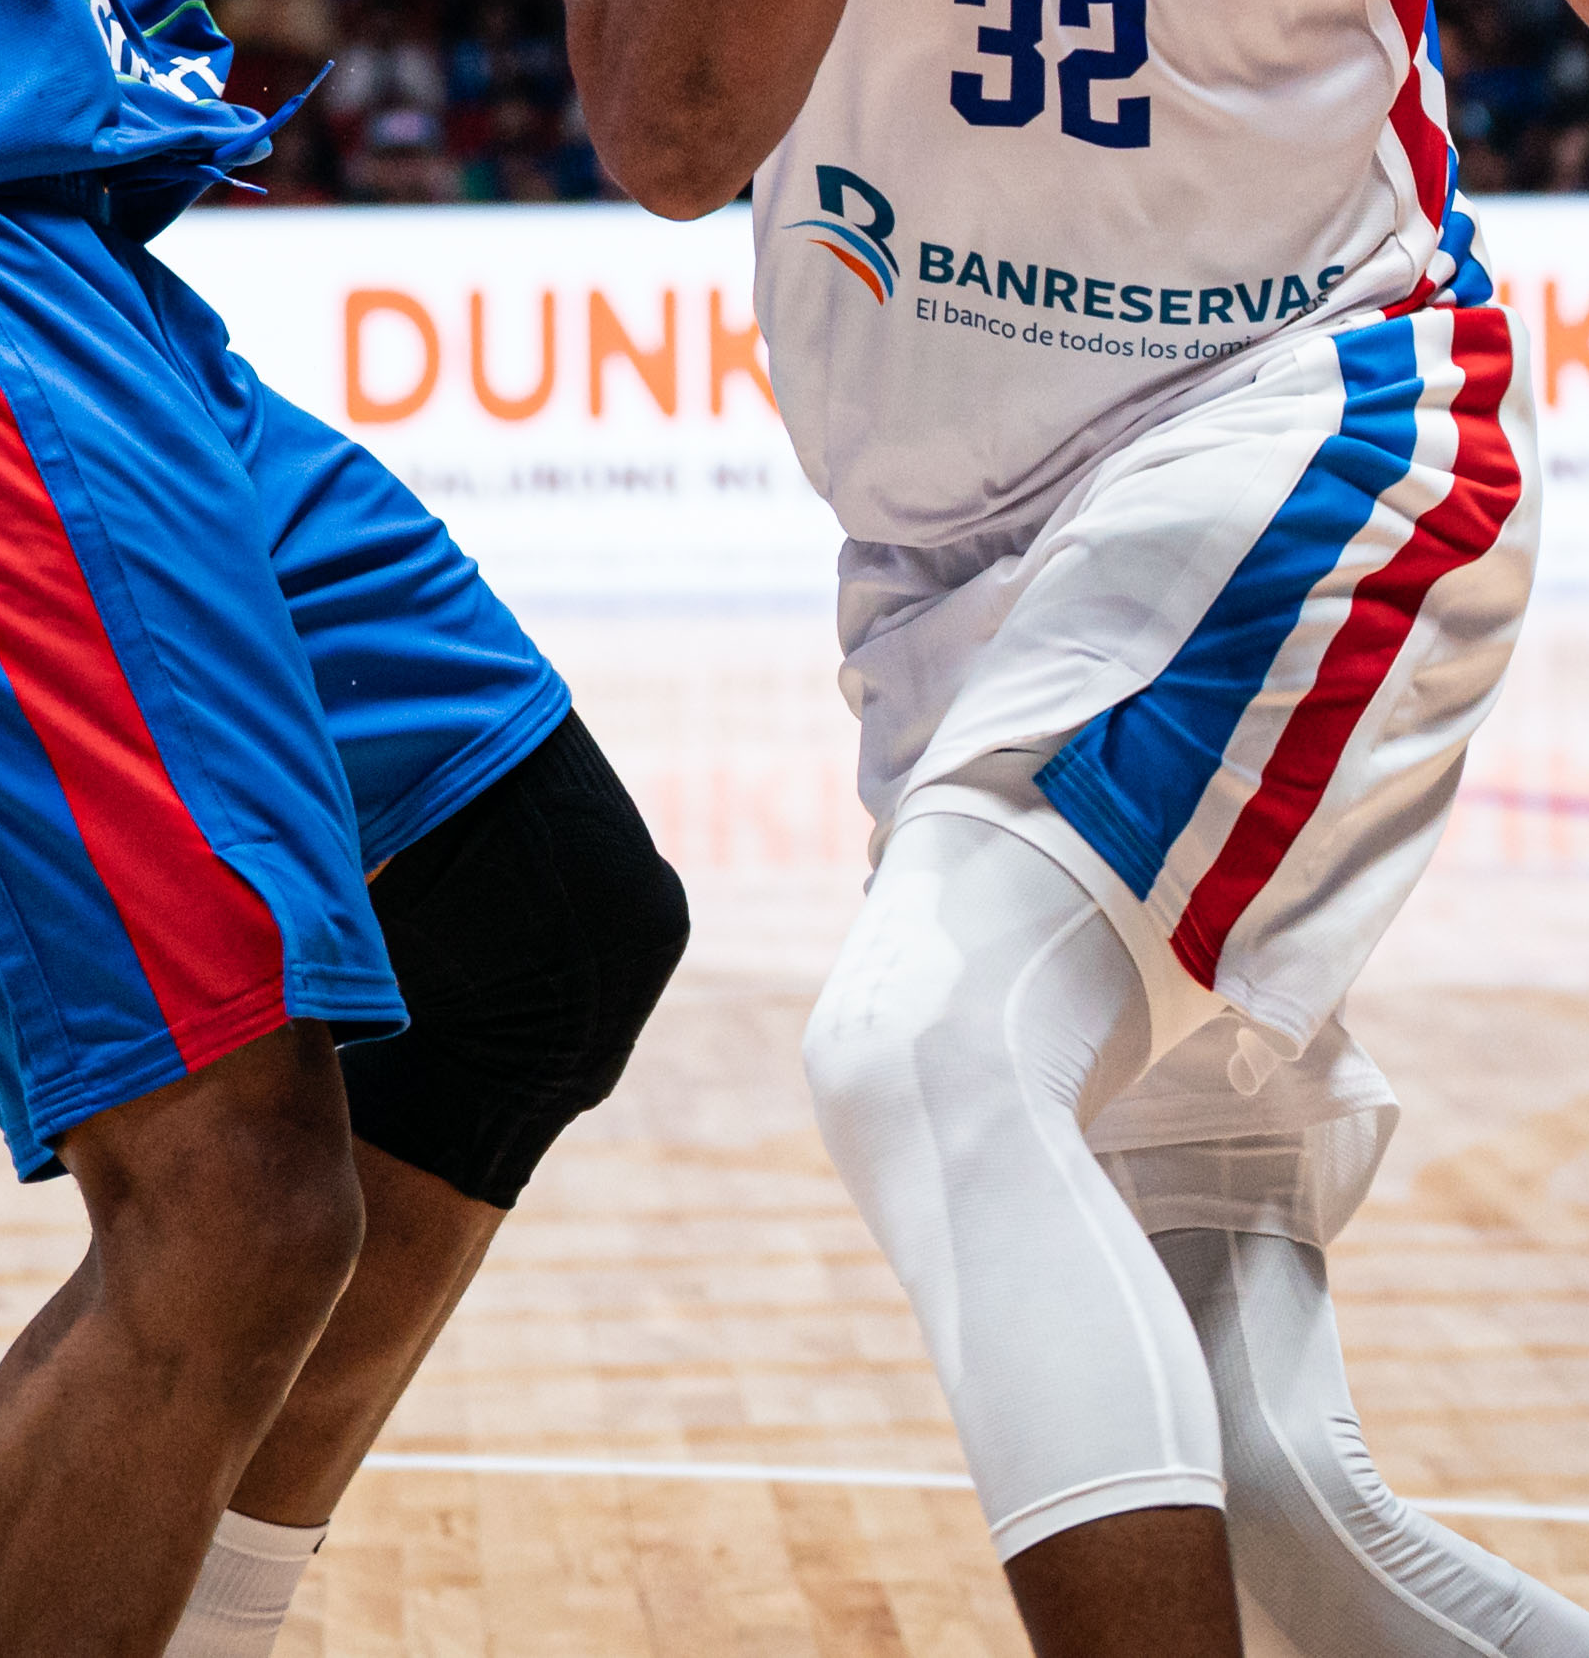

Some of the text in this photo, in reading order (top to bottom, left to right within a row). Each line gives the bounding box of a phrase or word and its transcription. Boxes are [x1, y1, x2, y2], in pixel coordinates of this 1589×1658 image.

[346, 288, 780, 424] DUNK
[916, 297, 937, 321] El
[944, 300, 1016, 339] banco
[1022, 322, 1053, 346] de
[1059, 330, 1134, 357] todos
[1141, 336, 1177, 360] los
